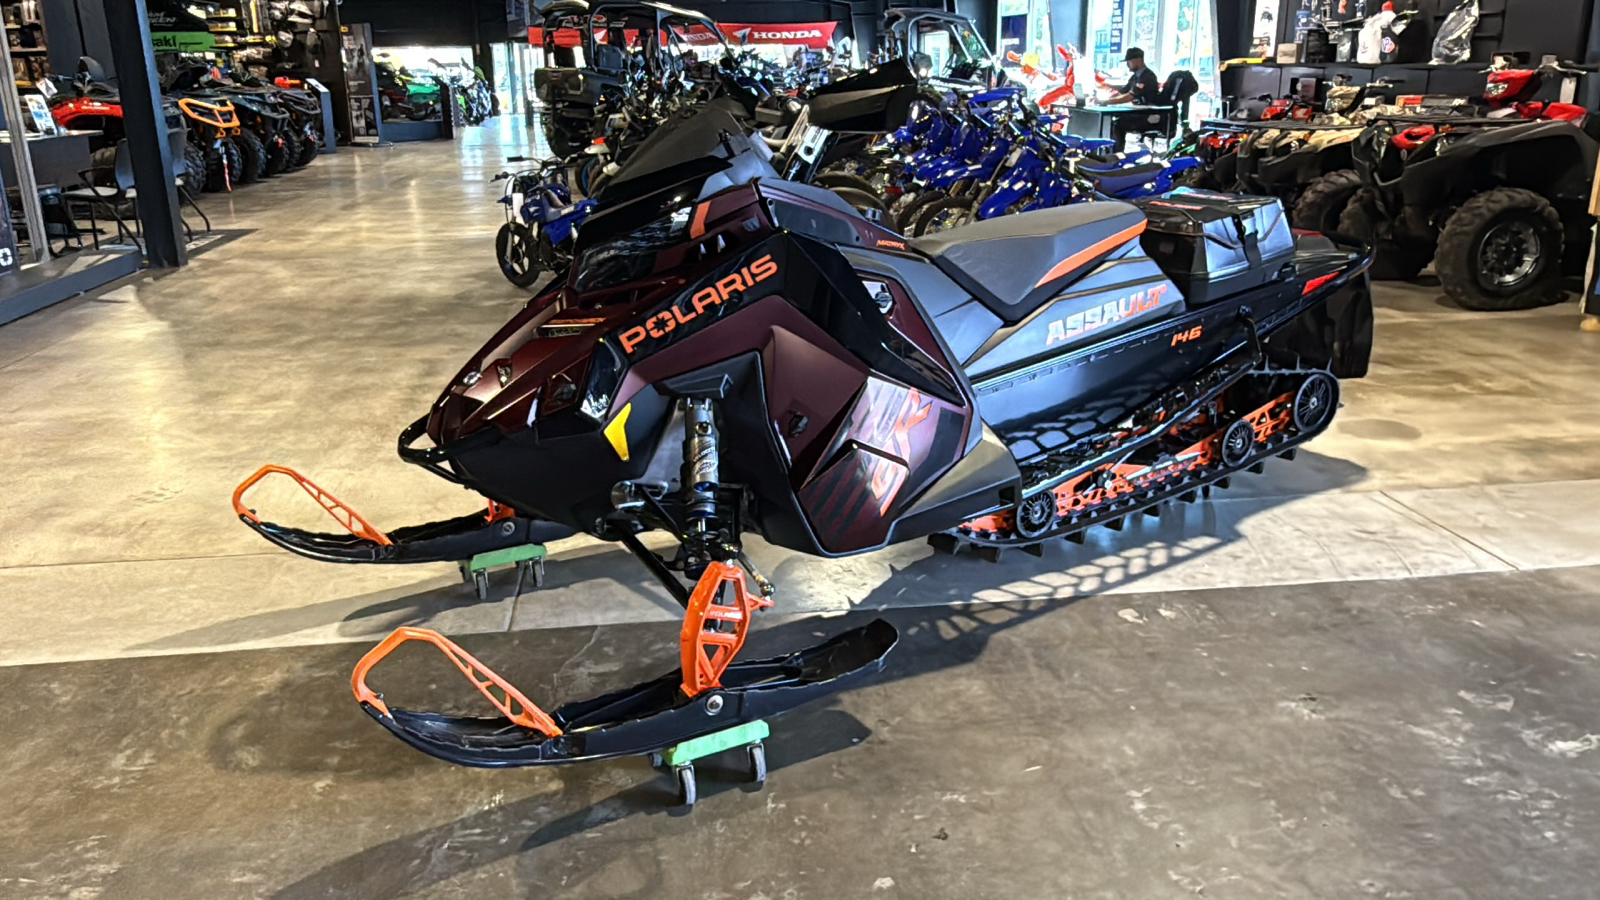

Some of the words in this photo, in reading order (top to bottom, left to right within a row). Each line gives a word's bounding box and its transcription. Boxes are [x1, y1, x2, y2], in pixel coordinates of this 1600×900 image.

[752, 29, 823, 39] HONDA
[618, 254, 779, 354] POLARIS
[1046, 284, 1168, 345] ASSAULT
[1171, 325, 1203, 347] 146
